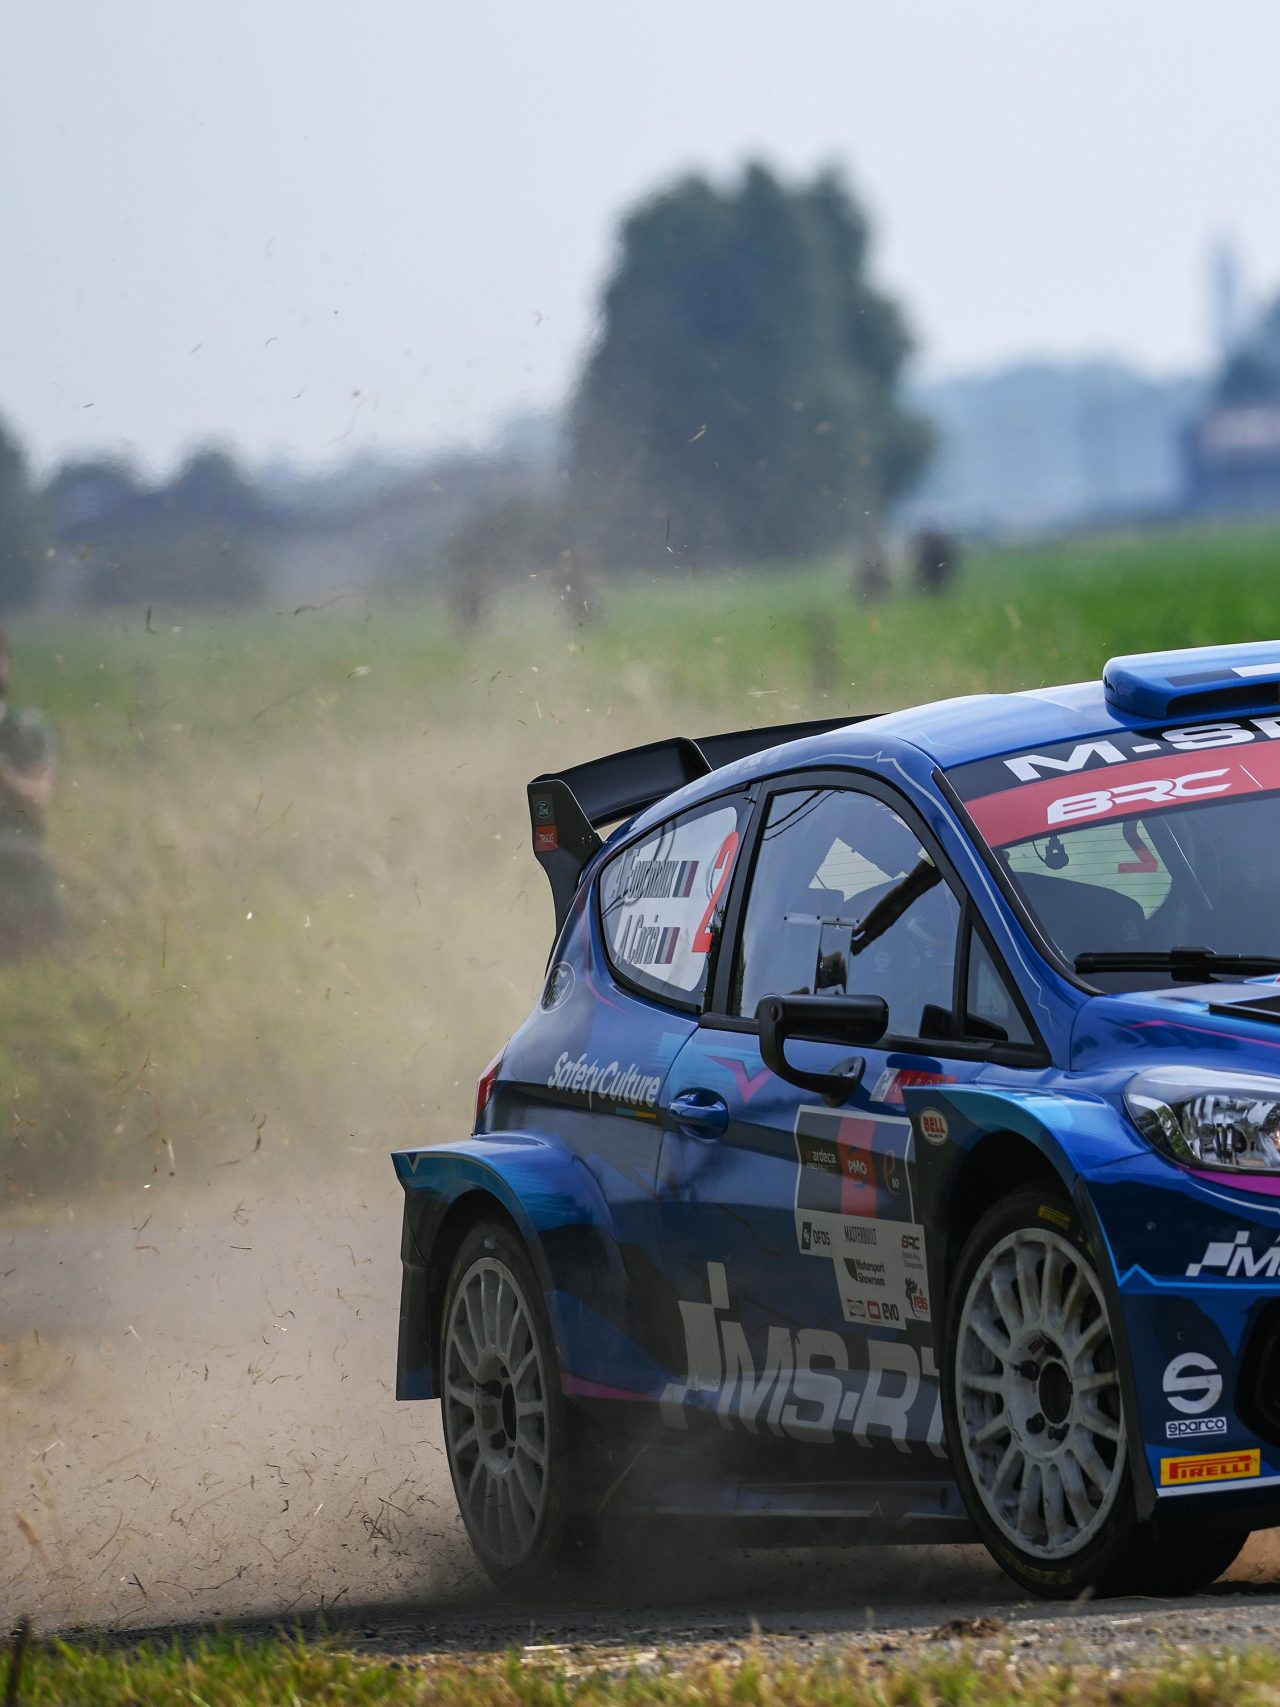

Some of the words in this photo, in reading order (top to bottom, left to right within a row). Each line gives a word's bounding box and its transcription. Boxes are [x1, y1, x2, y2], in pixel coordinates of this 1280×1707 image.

[1047, 768, 1231, 825] BRC
[691, 832, 739, 953] 2
[548, 1051, 661, 1110] SafetyCulture
[923, 1116, 945, 1133] BELL
[847, 1160, 868, 1175] PMO
[902, 1235, 920, 1250] BRC
[856, 1259, 885, 1274] Motorsport
[858, 1273, 885, 1287] Showroom
[882, 1303, 899, 1321] evo
[1168, 1418, 1226, 1437] sparco
[1169, 1455, 1251, 1480] PIRELLI
